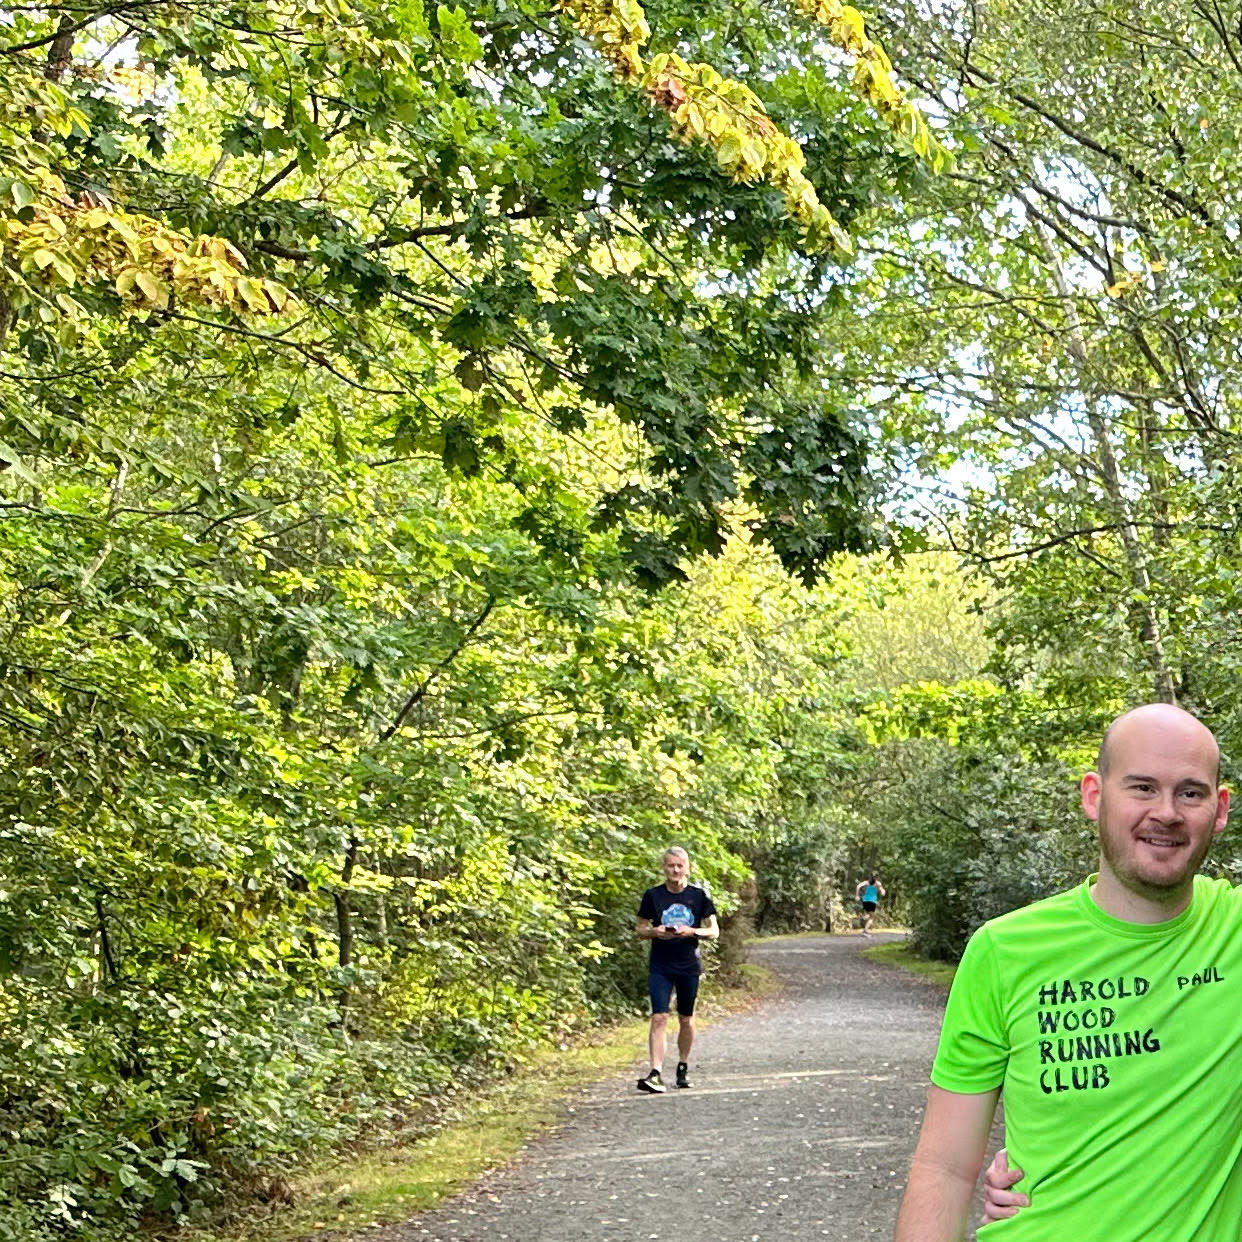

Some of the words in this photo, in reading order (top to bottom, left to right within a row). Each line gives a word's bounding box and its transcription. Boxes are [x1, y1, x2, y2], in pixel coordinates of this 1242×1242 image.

[1038, 976, 1150, 1006] HAROLD
[1177, 967, 1225, 990] PAUL
[1037, 1006, 1116, 1035] WOOD
[1038, 1028, 1161, 1065] RUNNING
[1039, 1063, 1110, 1094] CLUB
